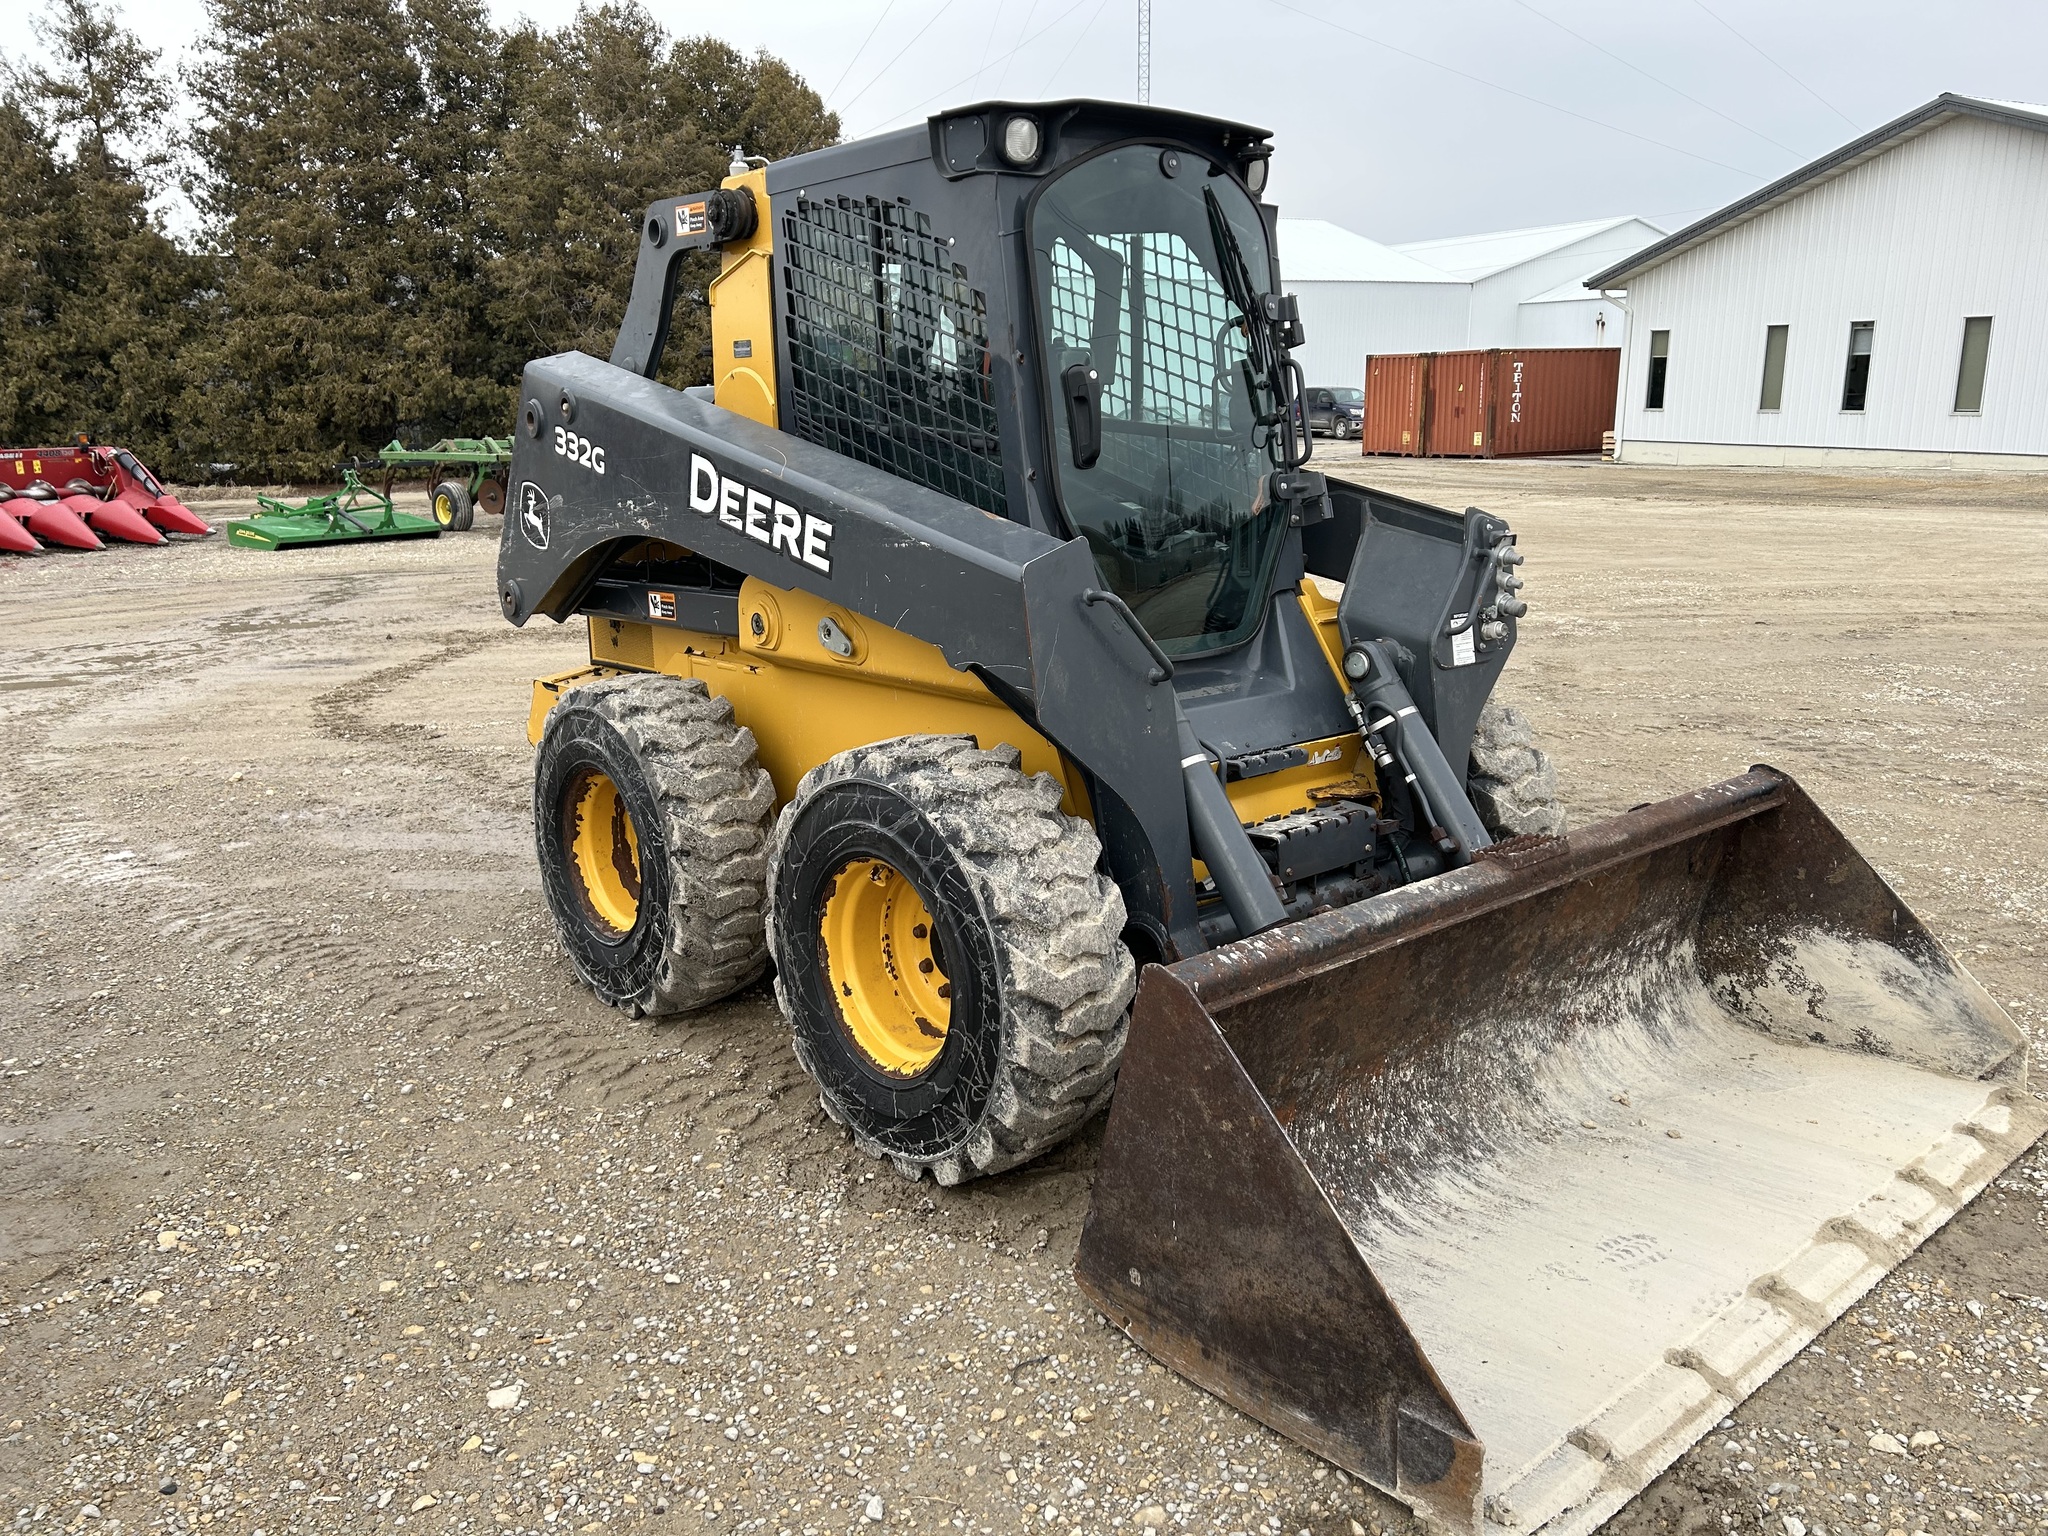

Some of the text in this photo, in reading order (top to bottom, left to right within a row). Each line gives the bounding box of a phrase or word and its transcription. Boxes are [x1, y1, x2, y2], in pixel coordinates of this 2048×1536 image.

[1510, 362, 1524, 423] TRITON
[554, 426, 605, 475] 332G
[689, 452, 833, 573] DEERE
